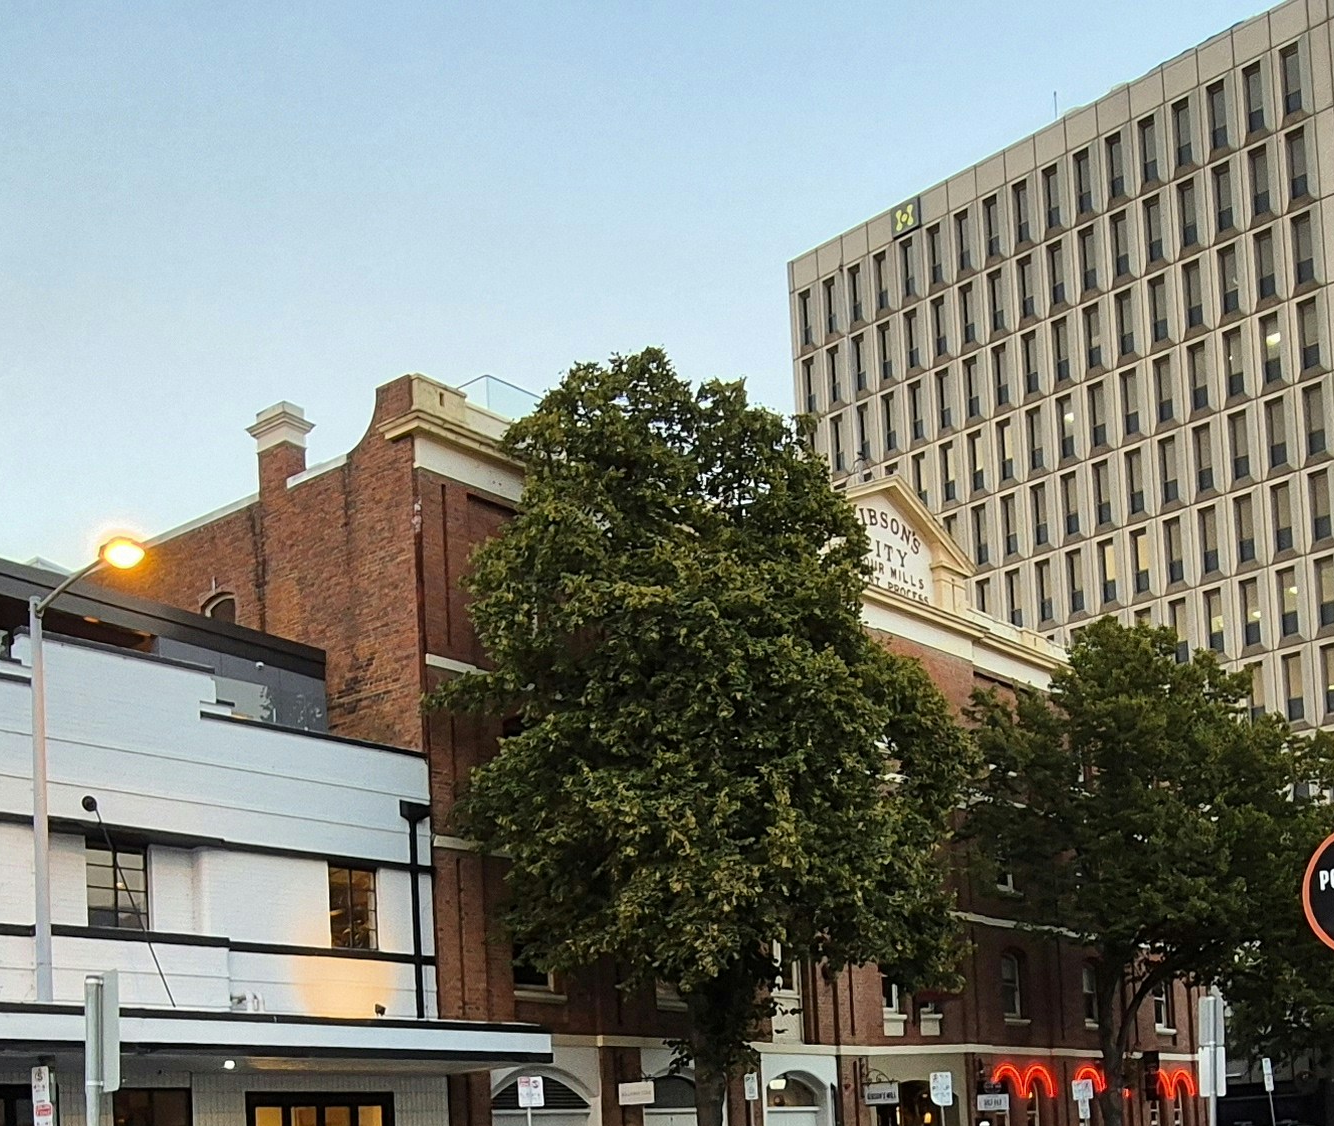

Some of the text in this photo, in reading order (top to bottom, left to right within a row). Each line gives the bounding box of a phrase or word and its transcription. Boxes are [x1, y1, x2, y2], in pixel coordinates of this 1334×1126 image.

[859, 508, 921, 555] IBSON'S
[875, 540, 907, 567] ITY
[890, 567, 924, 589] MILLS
